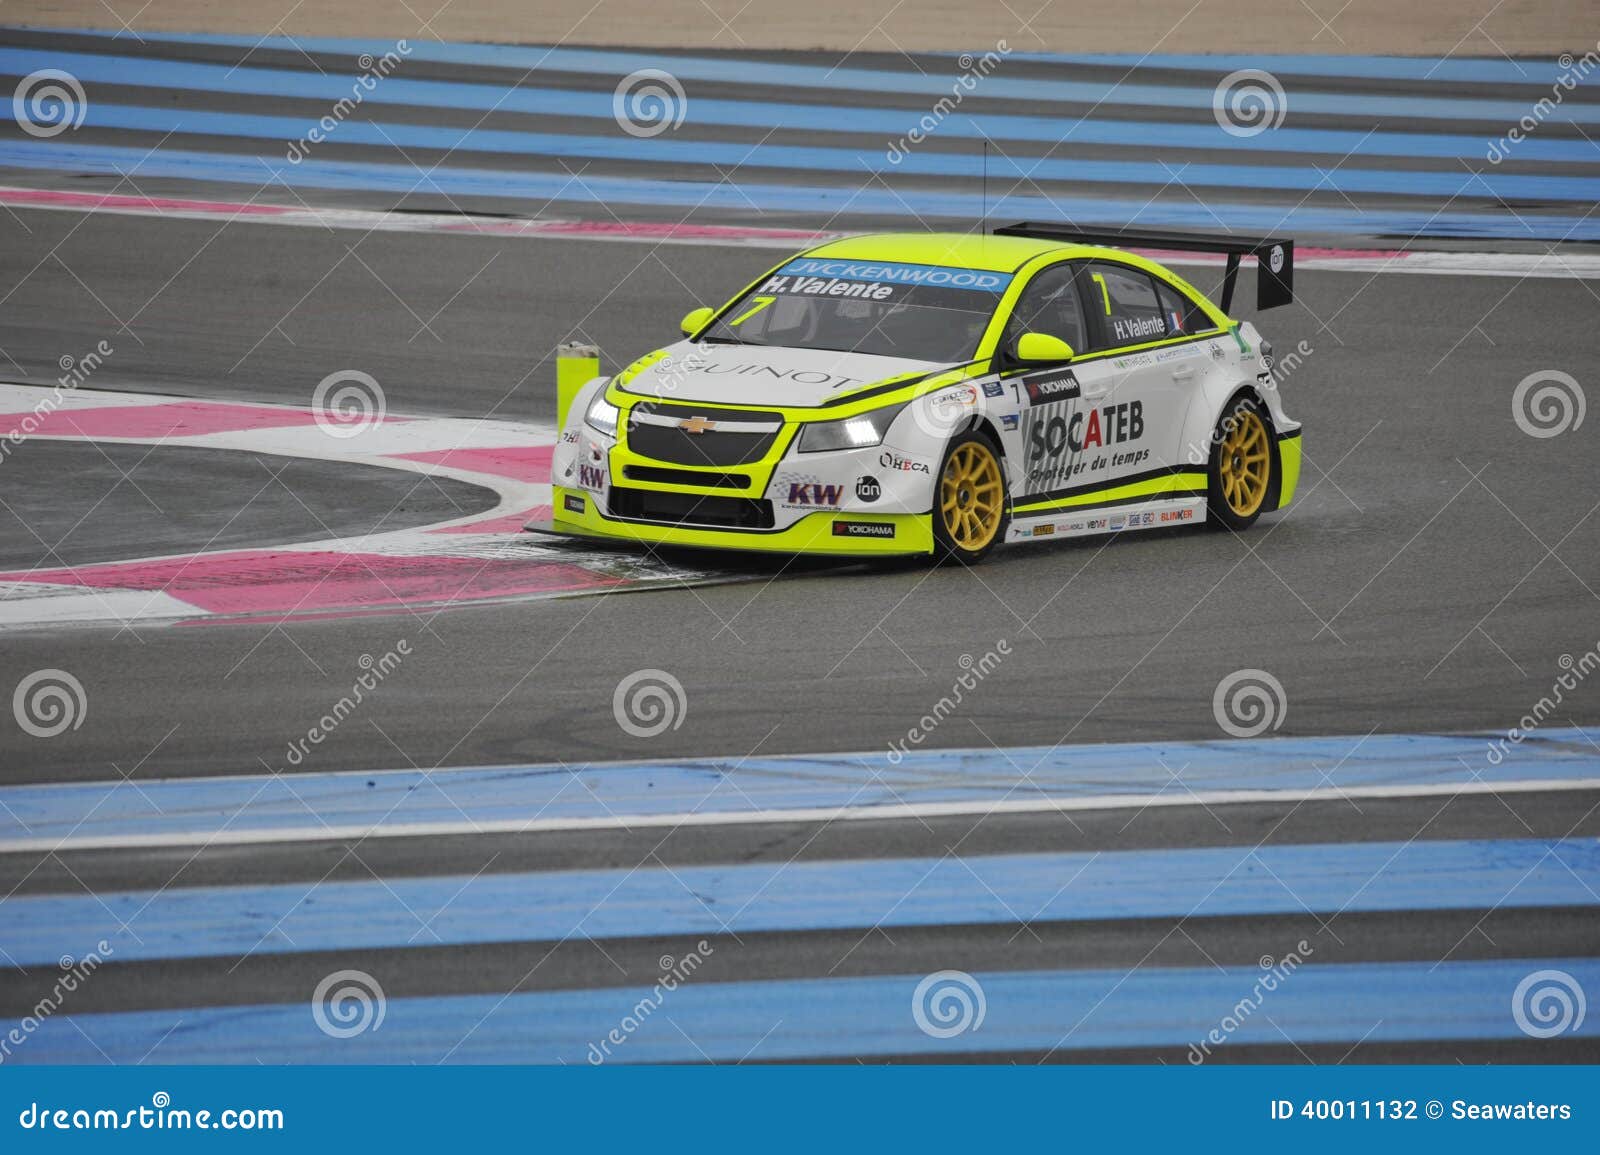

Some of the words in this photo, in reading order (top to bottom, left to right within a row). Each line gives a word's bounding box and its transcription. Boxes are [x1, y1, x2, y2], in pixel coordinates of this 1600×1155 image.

[789, 261, 1000, 289] JVCKENWOOD
[758, 275, 894, 300] H.Valente
[729, 296, 777, 326] 7
[1113, 316, 1166, 340] H.Valente
[1010, 383, 1020, 404] 7
[1037, 377, 1078, 394] YOKOHAMA
[1030, 400, 1145, 461] SOCATEB
[1091, 455, 1107, 471] du
[1112, 448, 1150, 466] temps
[579, 464, 605, 489] KW
[788, 482, 844, 505] KW
[1160, 509, 1193, 522] BLINKER
[848, 525, 894, 535] YOKOHAMA
